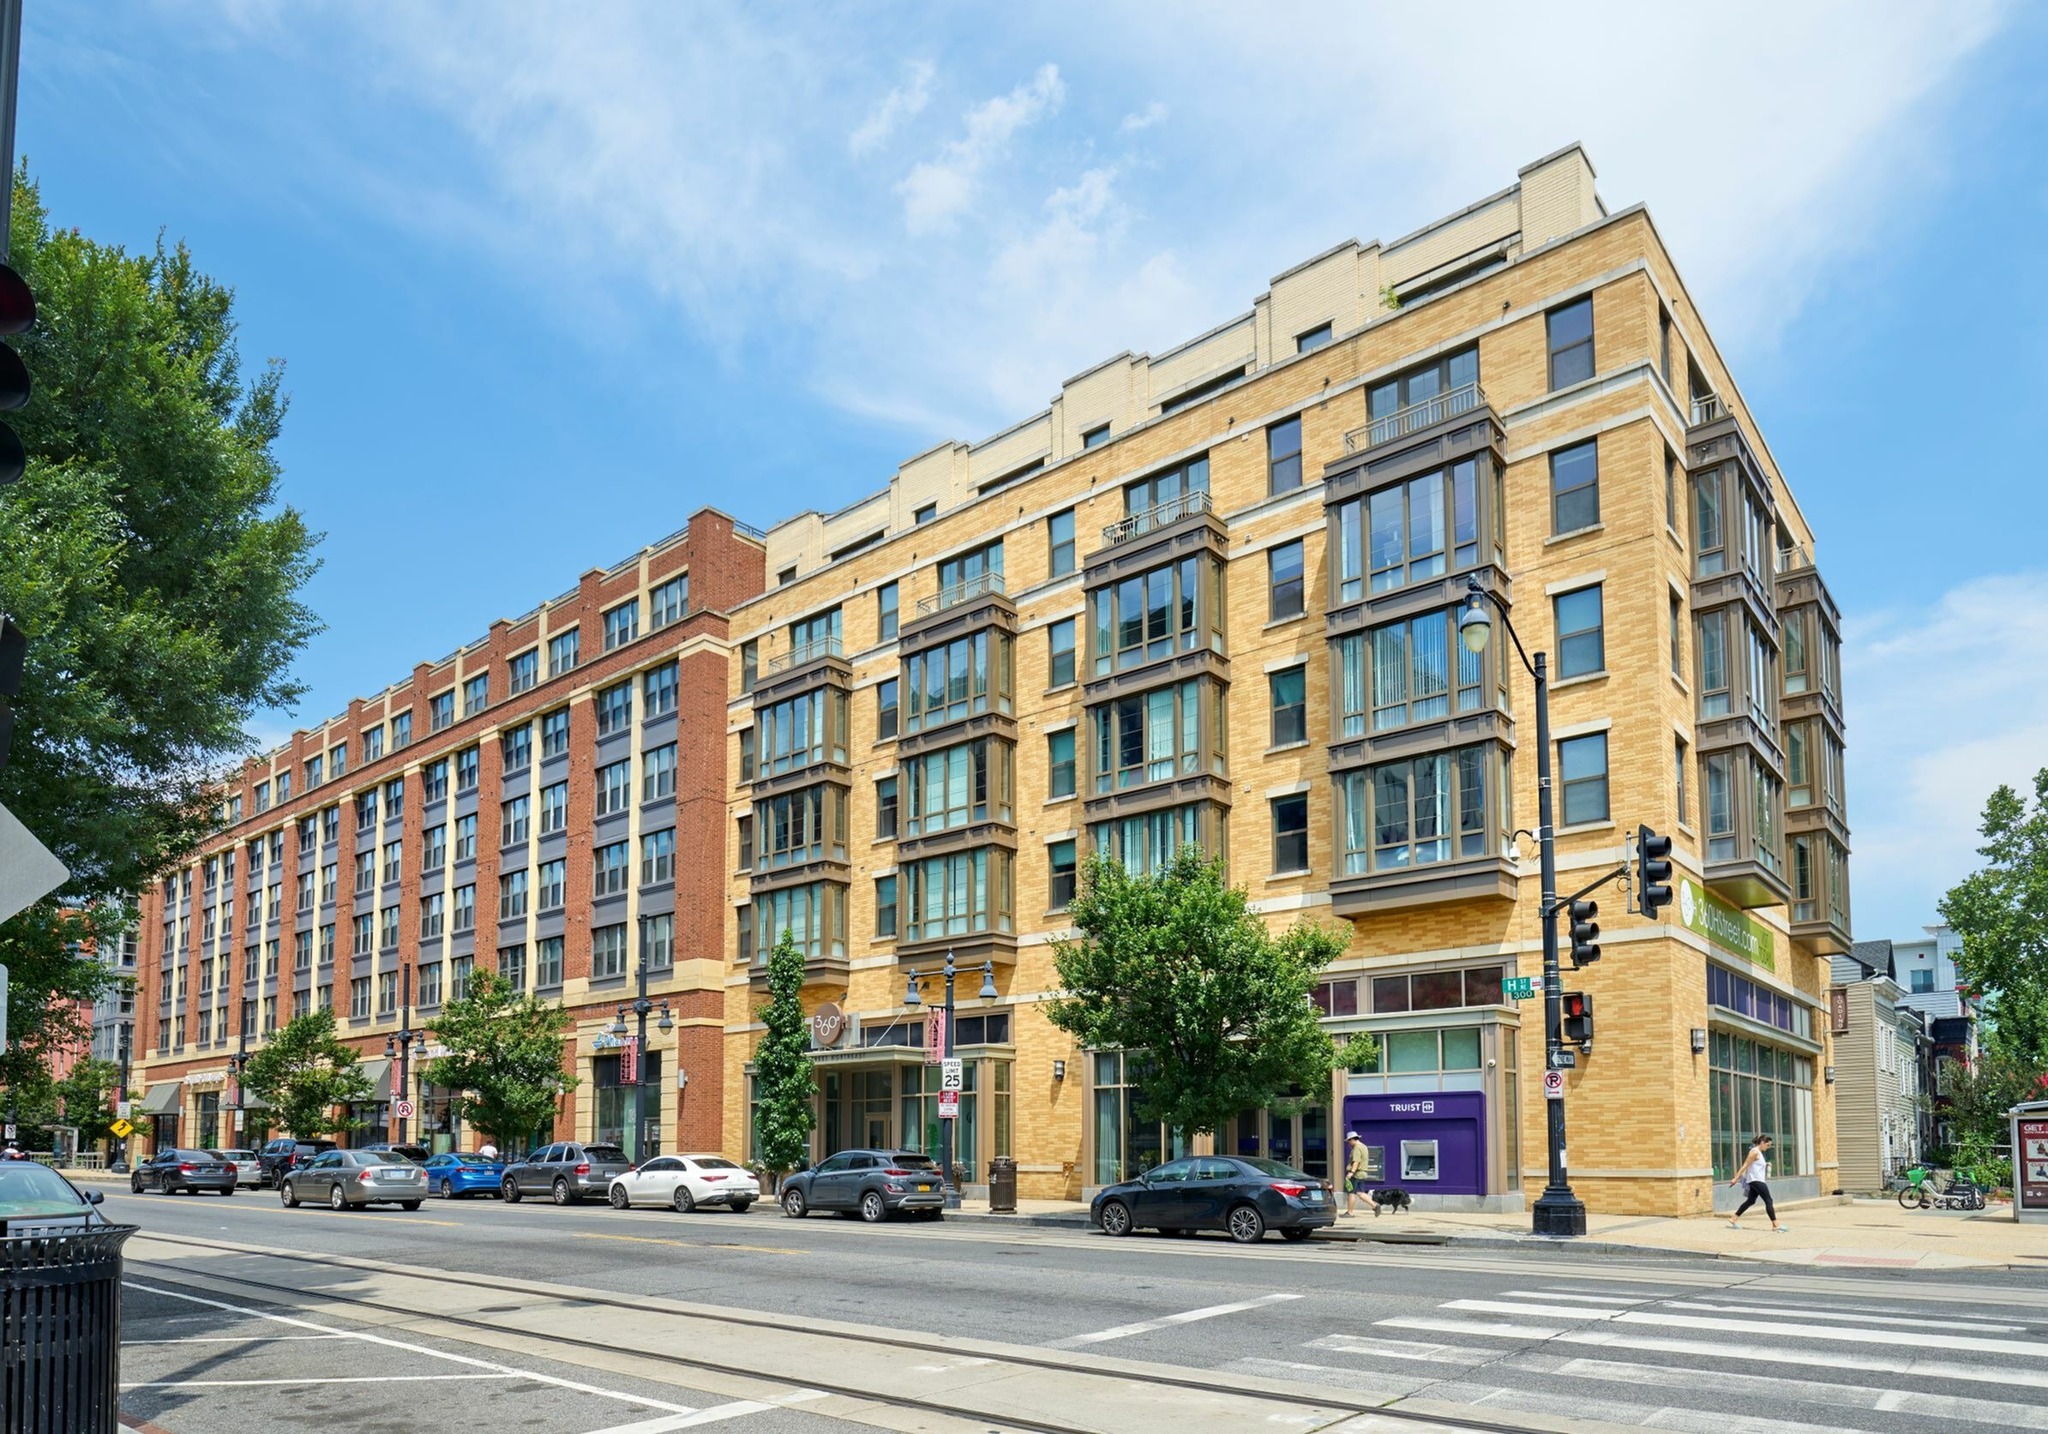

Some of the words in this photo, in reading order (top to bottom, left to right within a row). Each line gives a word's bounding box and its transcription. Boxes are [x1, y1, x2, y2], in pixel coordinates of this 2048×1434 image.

[1507, 980, 1516, 991] H
[1514, 991, 1532, 999] 300
[945, 1075, 960, 1087] 25
[1390, 1104, 1421, 1112] TRUIST
